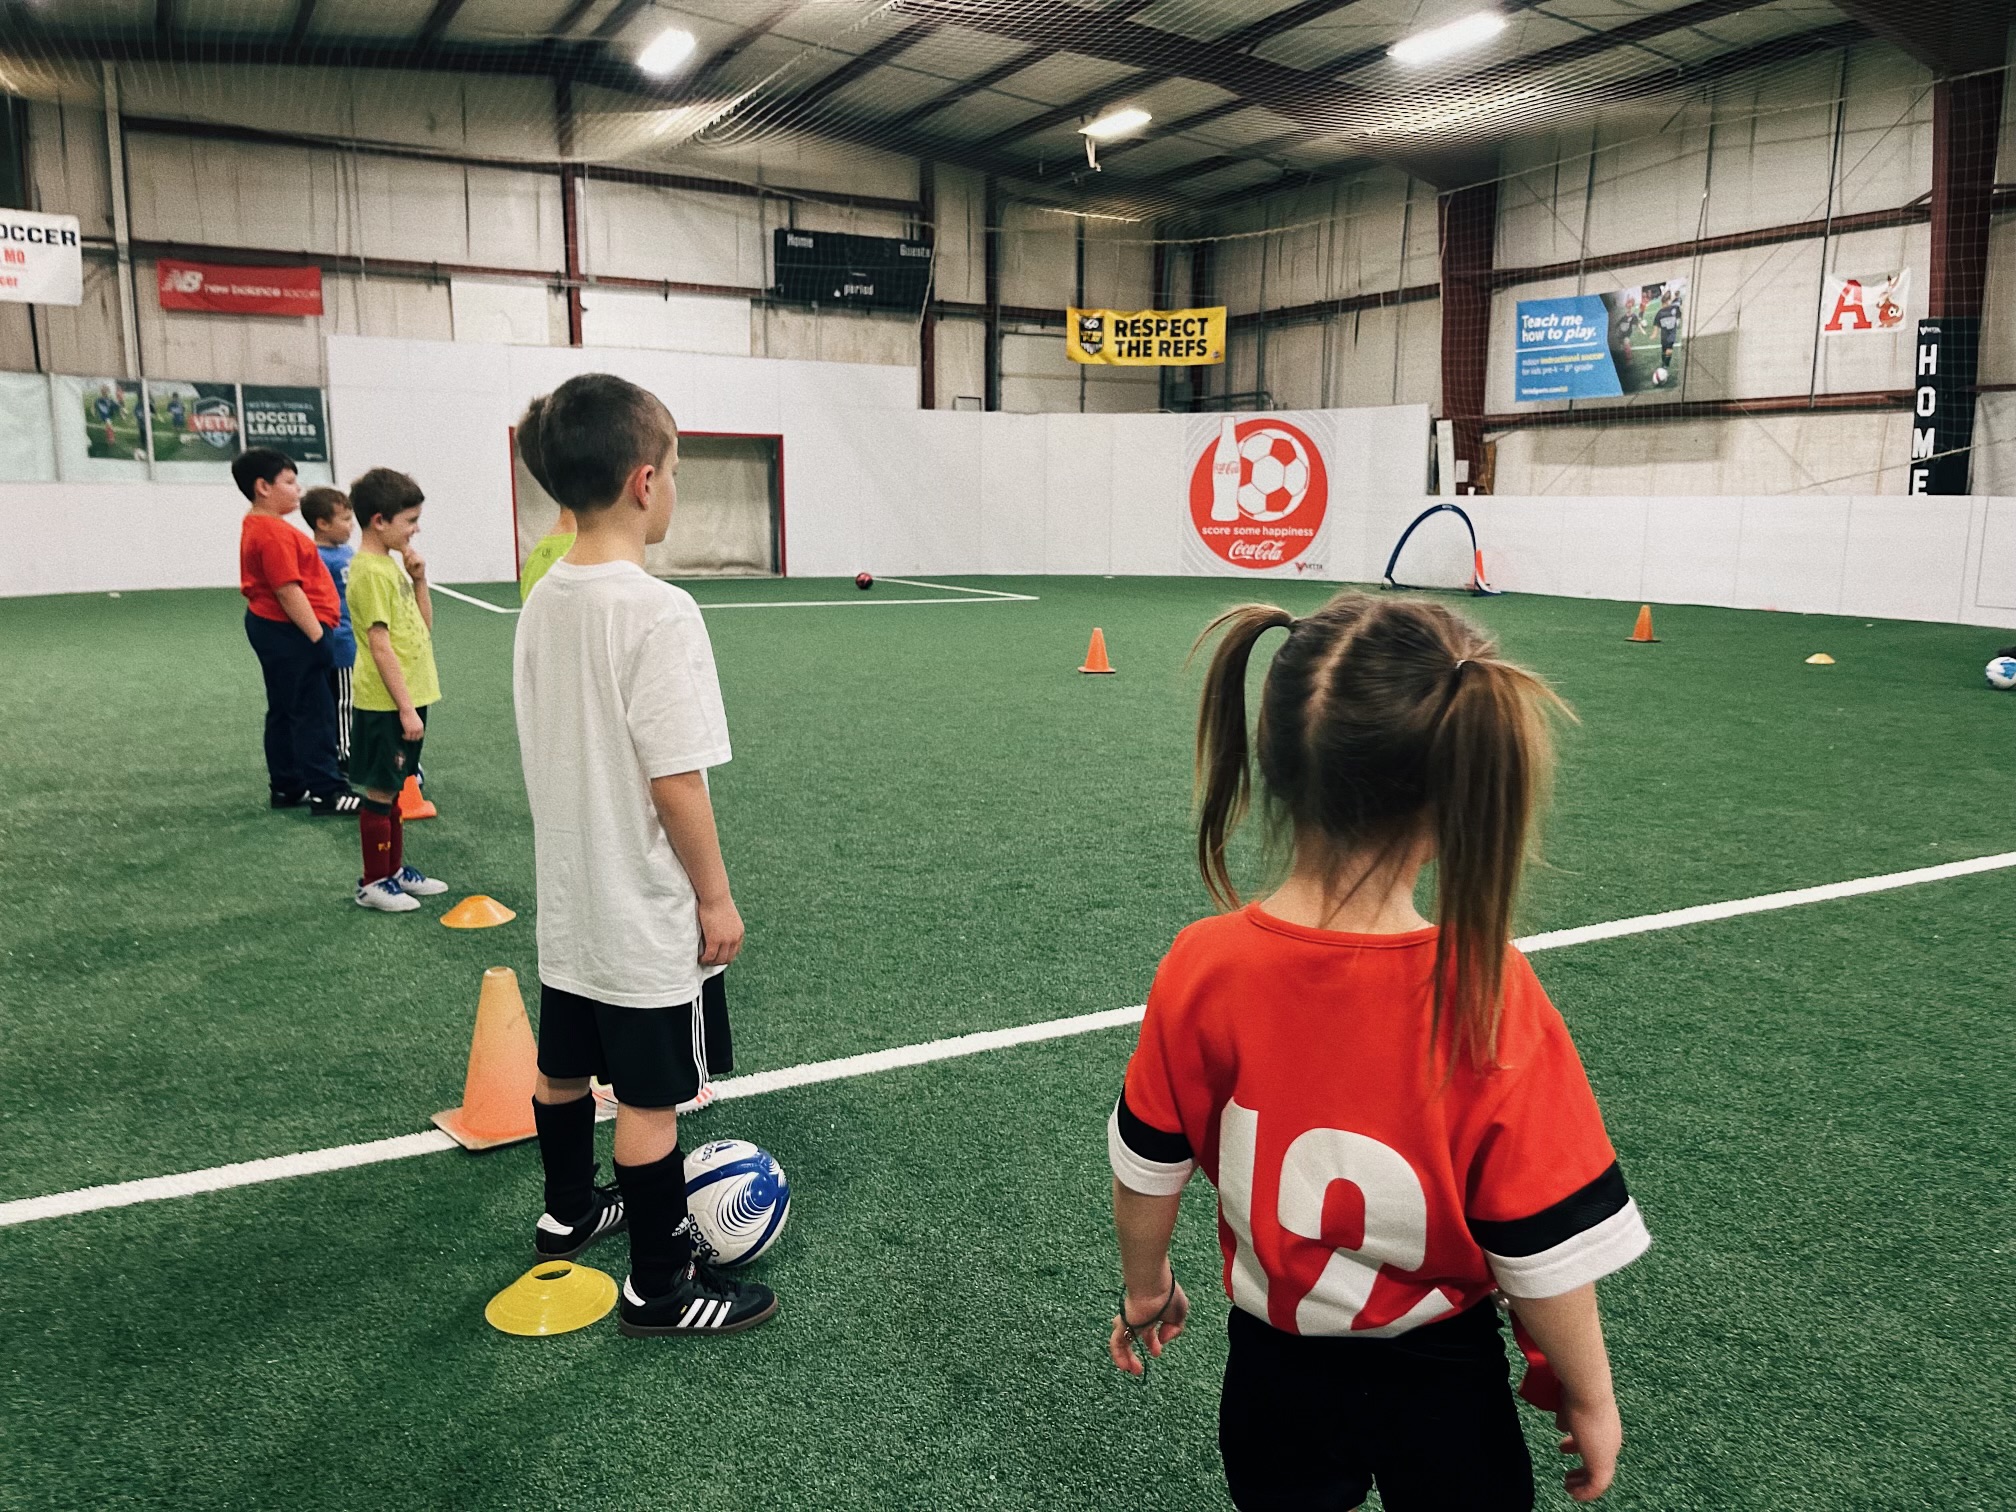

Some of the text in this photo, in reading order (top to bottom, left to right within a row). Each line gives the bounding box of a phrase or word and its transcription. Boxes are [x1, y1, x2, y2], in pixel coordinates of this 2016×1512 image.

[786, 233, 814, 249] Home
[1824, 279, 1872, 331] A
[1114, 318, 1208, 338] RESPECT
[1521, 313, 1584, 329] Teach me
[1521, 325, 1597, 343] how to play.
[1115, 339, 1208, 358] THE REFS
[246, 411, 307, 424] SOCCER
[1911, 343, 1938, 496] HOME
[248, 424, 317, 436] LEAGUES
[1201, 525, 1314, 537] score some happiness
[1218, 1096, 1455, 1339] 12
